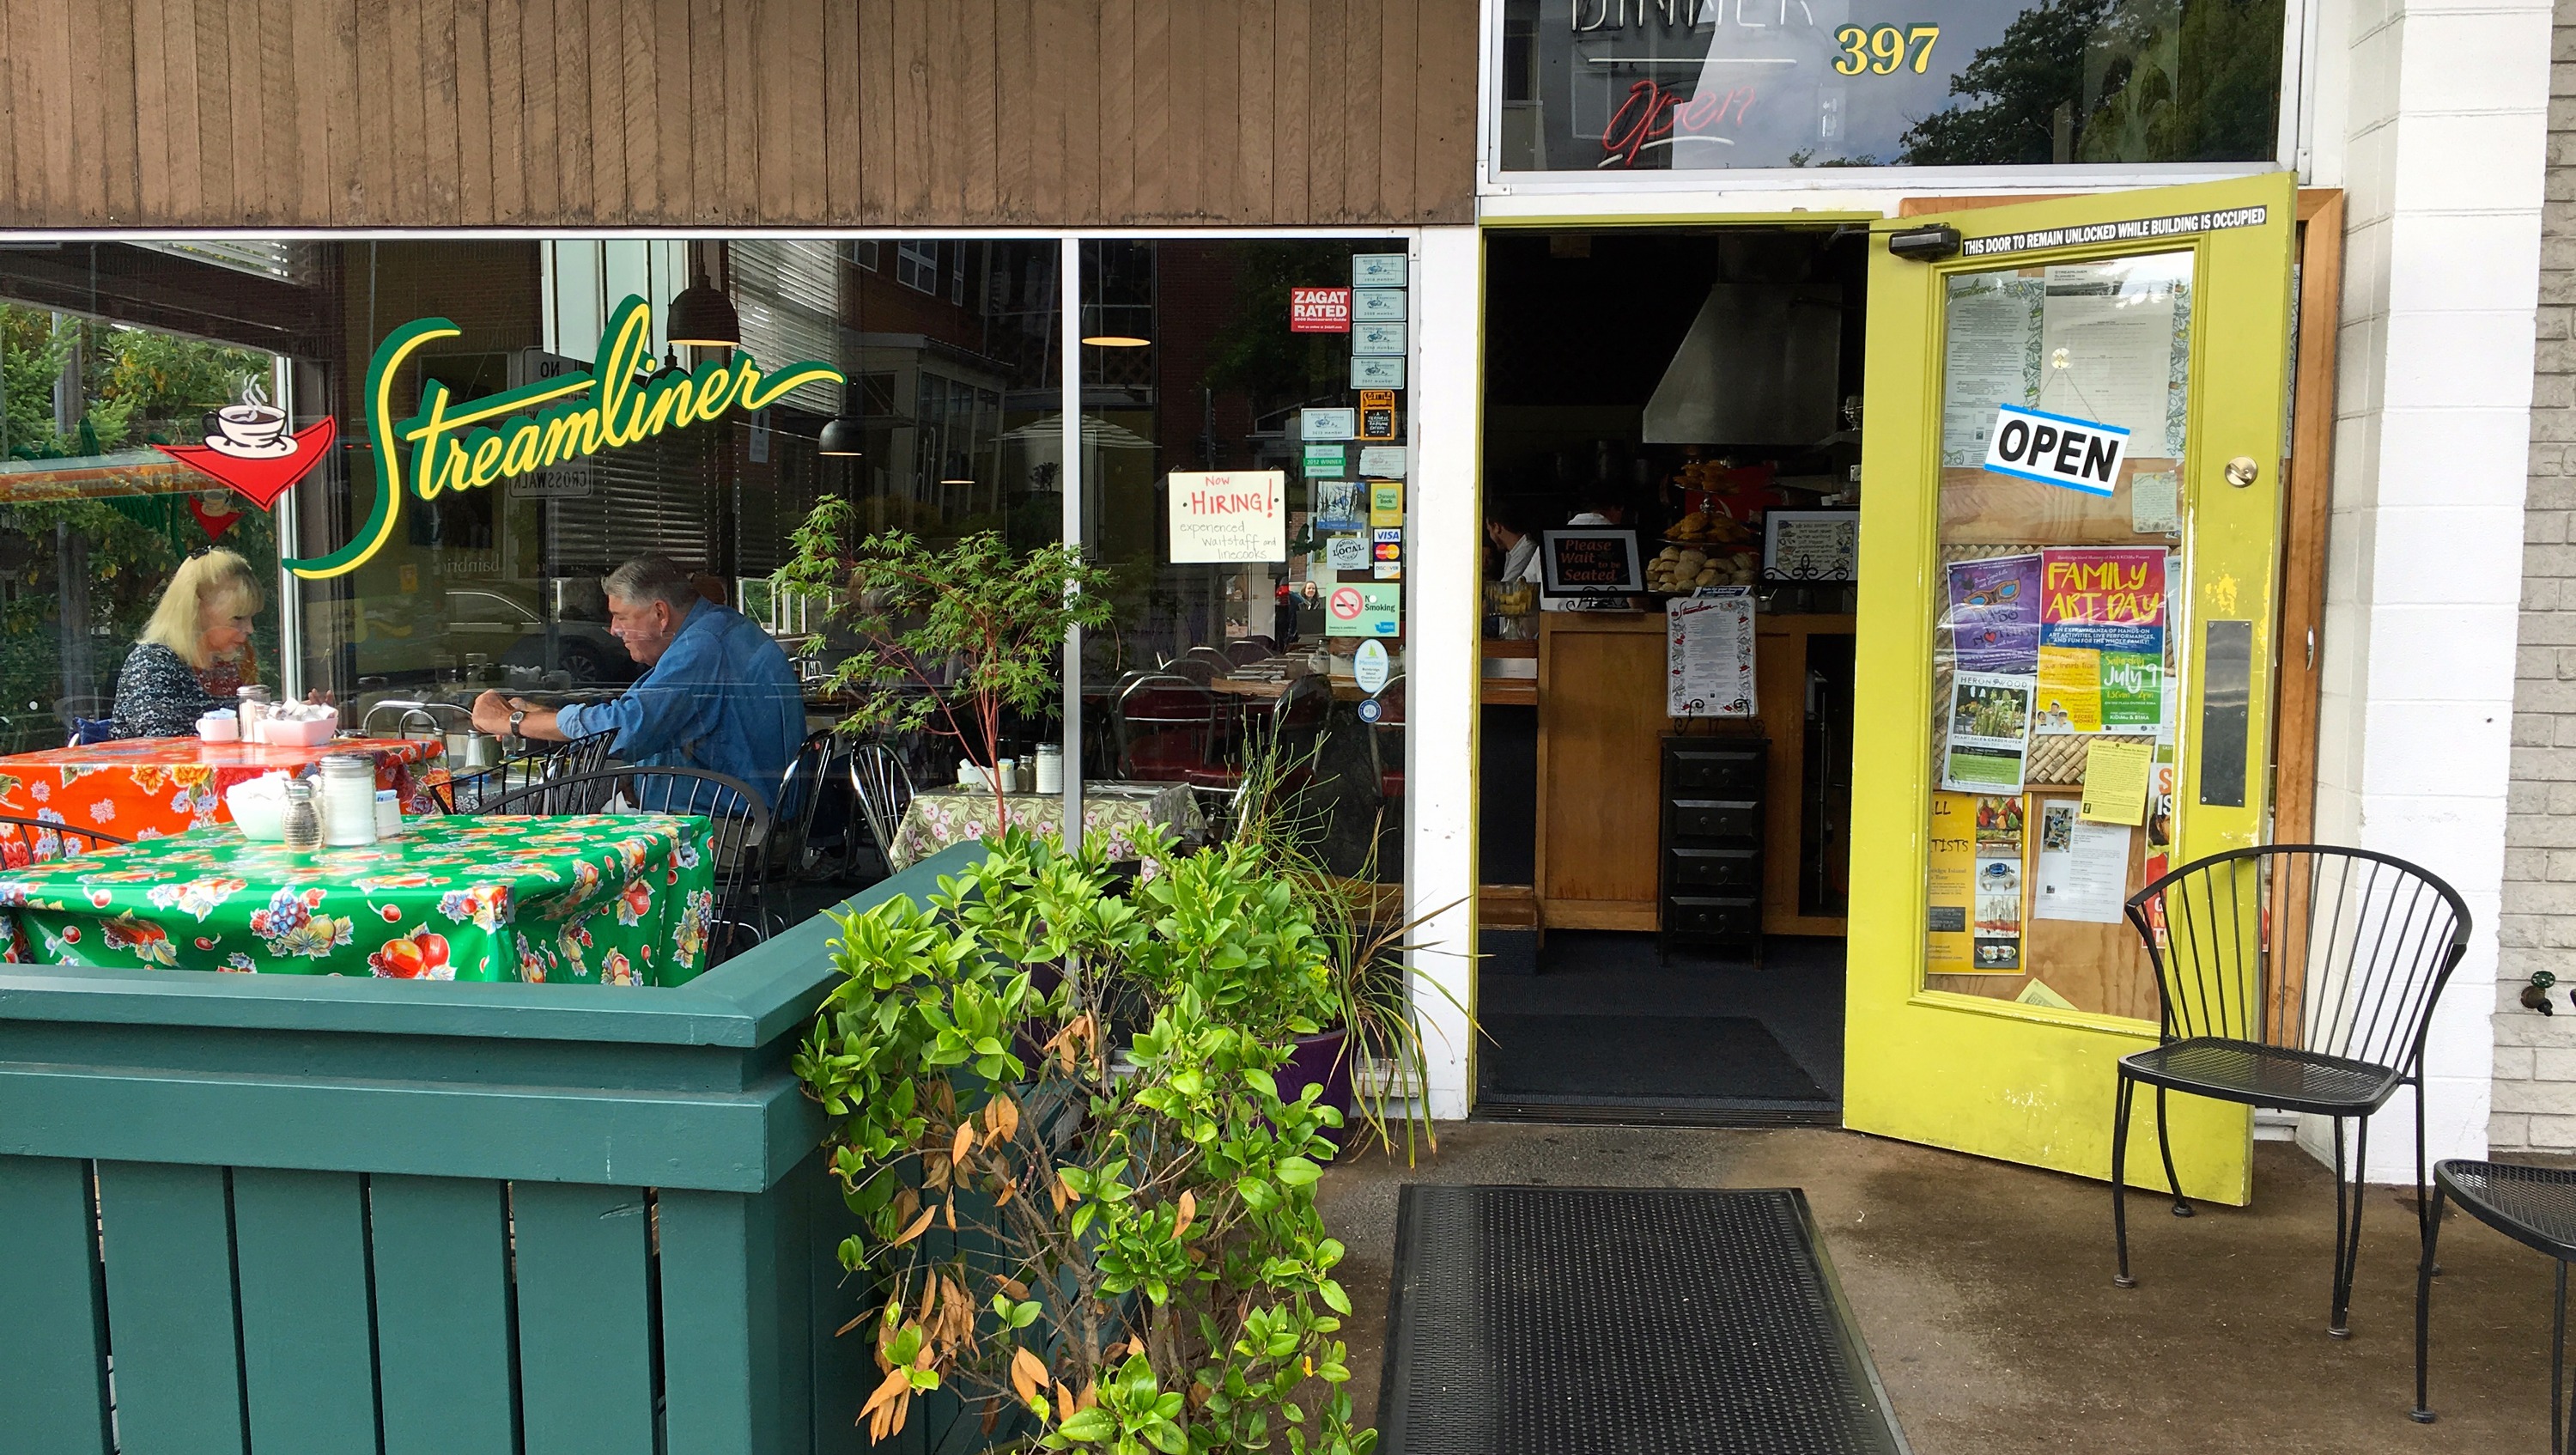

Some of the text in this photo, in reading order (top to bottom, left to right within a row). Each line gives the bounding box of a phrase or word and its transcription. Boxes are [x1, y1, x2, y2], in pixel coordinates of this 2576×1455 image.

[1832, 22, 1940, 76] 397
[1601, 79, 1755, 166] Open
[1964, 207, 2265, 255] THIS DOOR TO REMAIN UNLOCKED WHILE BUILDING IS OCCUPIED
[1294, 291, 1347, 304] ZAGAT
[1294, 305, 1347, 317] RATED
[283, 293, 848, 580] Streamliner
[1998, 419, 2119, 483] OPEN
[1191, 478, 1273, 518] HIRING!
[1180, 521, 1245, 539] experienced
[1377, 531, 1400, 540] VISA
[1263, 537, 1276, 546] and
[1565, 539, 1612, 551] Please
[1333, 544, 1364, 557] LOCAL
[1560, 551, 1595, 563] Wait
[2048, 562, 2148, 590] FAMILY
[1364, 603, 1395, 612] Smoking
[2045, 592, 2160, 622] ART DAY
[2105, 655, 2145, 668] Saturday
[2104, 663, 2142, 694] July
[2146, 663, 2157, 687] 9
[1932, 801, 1951, 816] LL
[1931, 838, 1968, 852] TISTS
